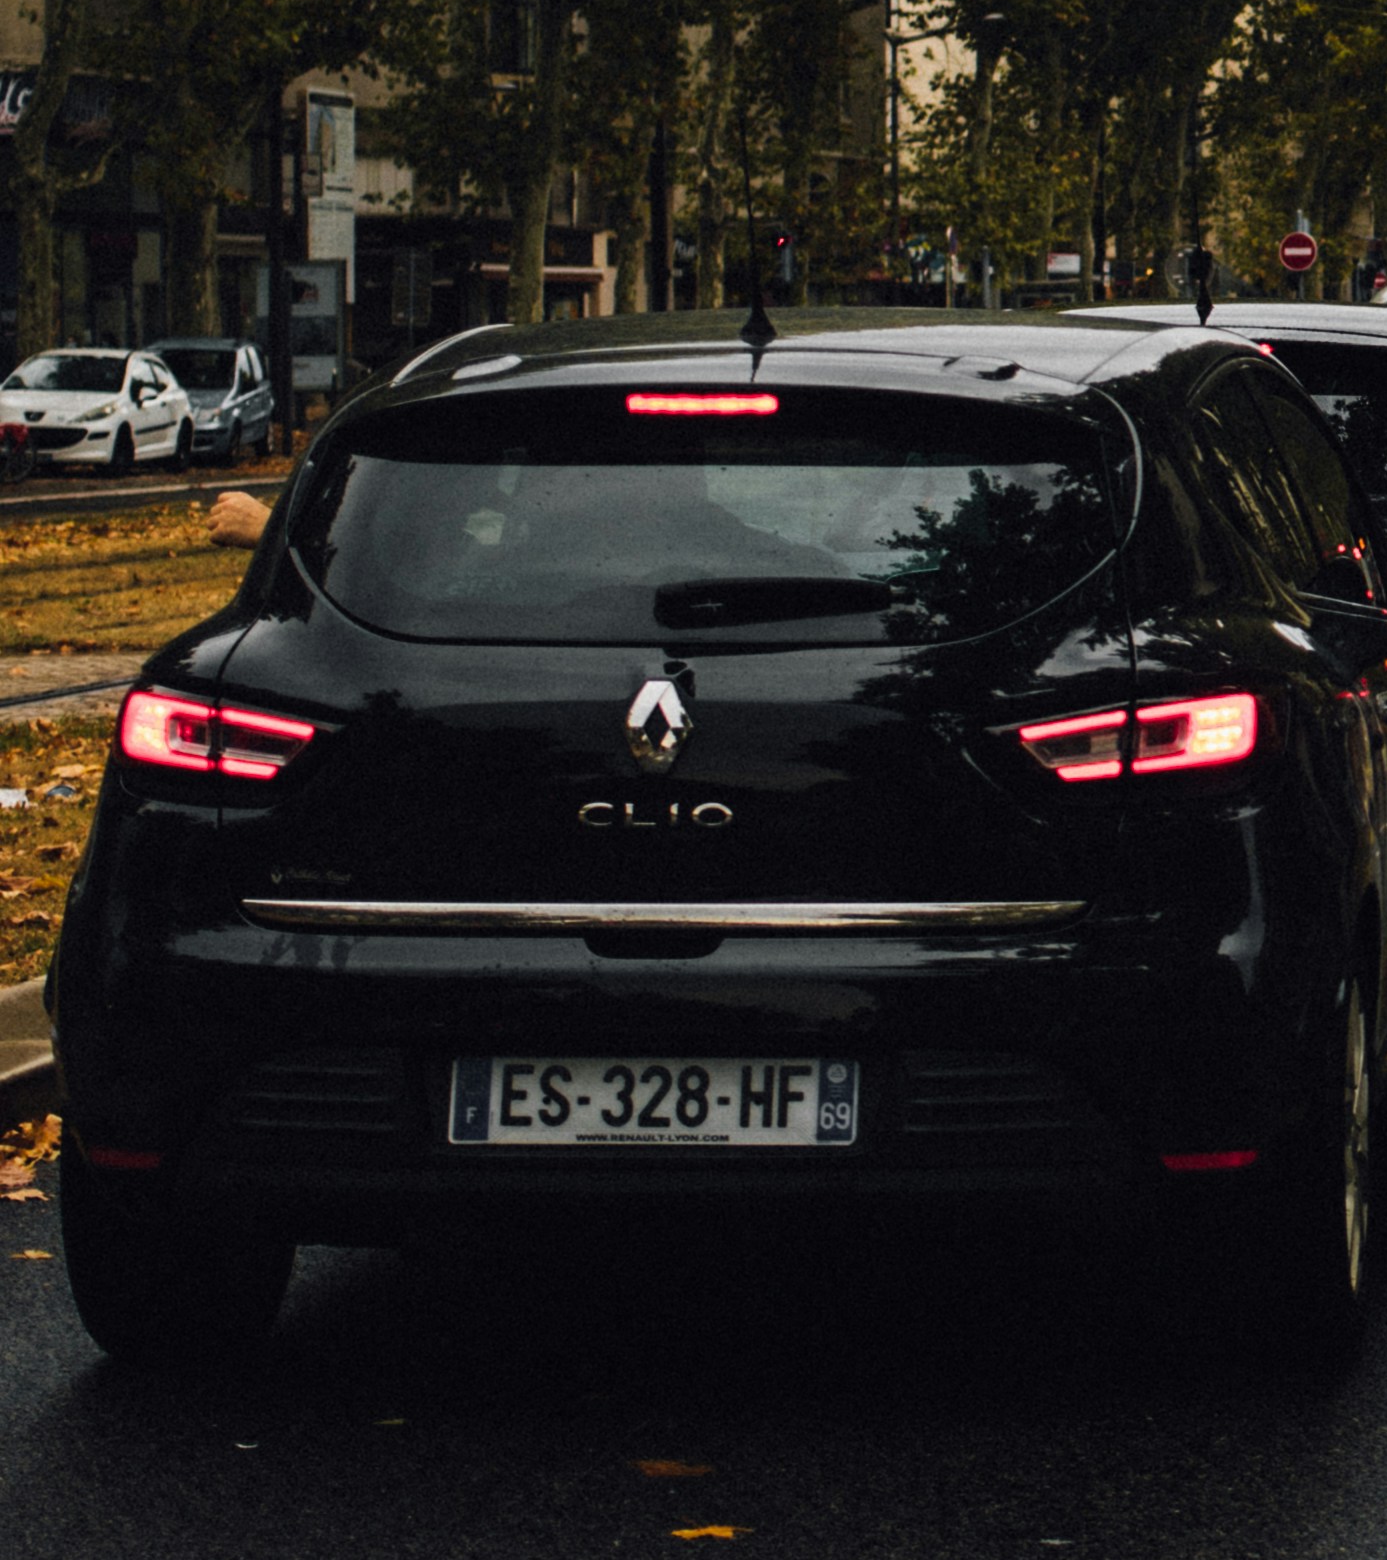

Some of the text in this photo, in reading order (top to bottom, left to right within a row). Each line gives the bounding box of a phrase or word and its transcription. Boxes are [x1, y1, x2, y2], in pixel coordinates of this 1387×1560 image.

[578, 801, 734, 827] CLIO
[466, 1064, 851, 1130] F ES-328-HF 69
[575, 1133, 730, 1143] WWW.RENAULT-LYON.COM
